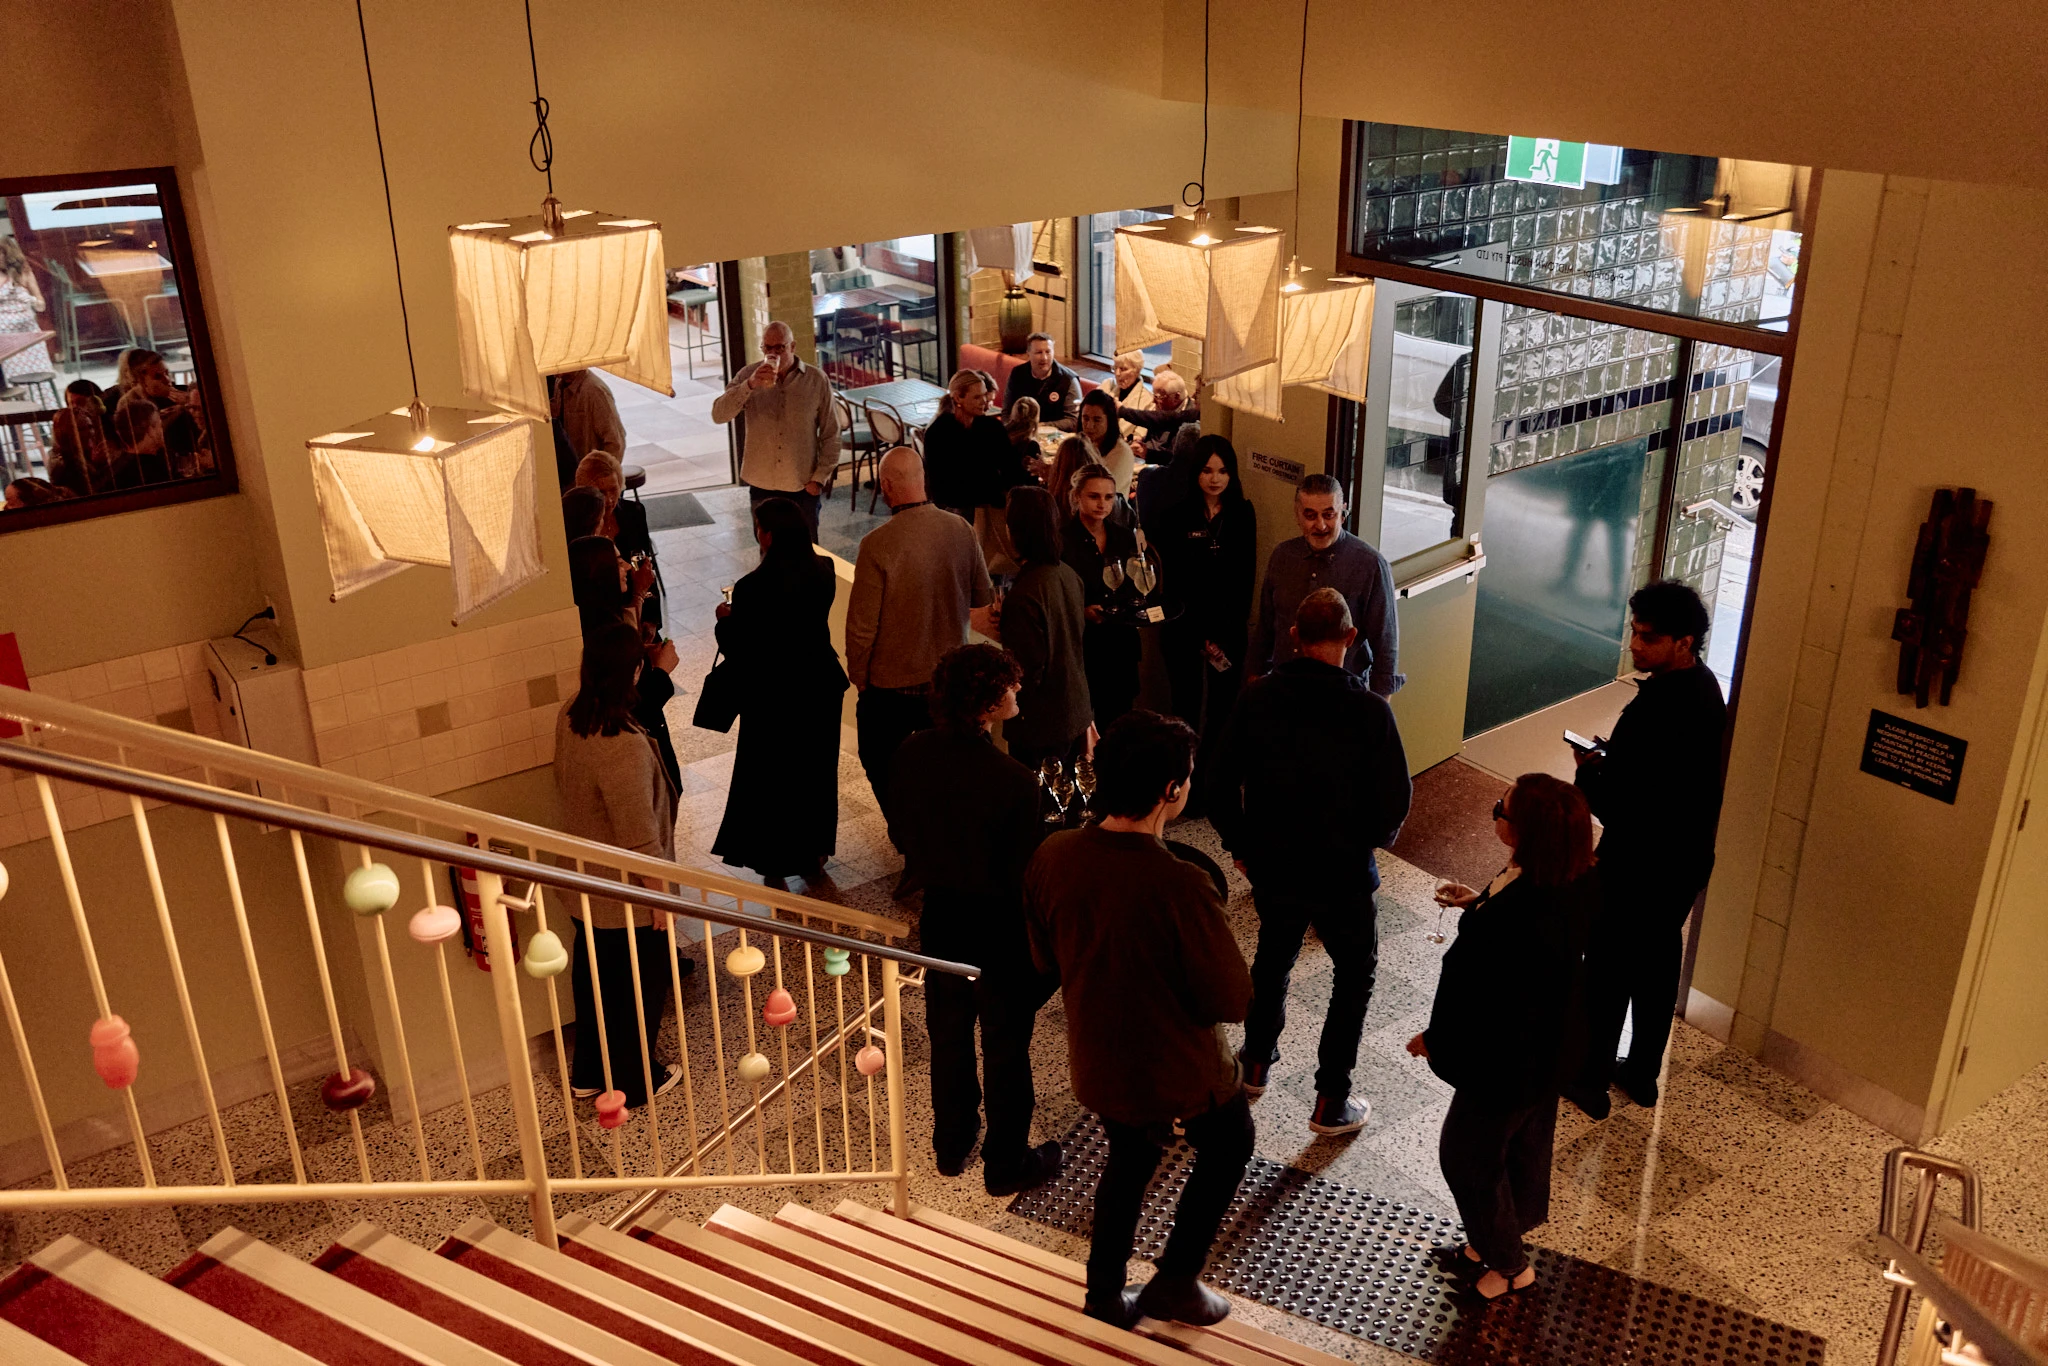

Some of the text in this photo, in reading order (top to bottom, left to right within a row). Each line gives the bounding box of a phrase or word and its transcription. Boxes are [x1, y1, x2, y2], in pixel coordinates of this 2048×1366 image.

[1252, 452, 1300, 474] FIRE CURTAIN
[1272, 469, 1297, 480] OBSTRUCT
[1885, 723, 1949, 750] PLEASE RESPECT OUR
[1881, 737, 1909, 750] MAINTAIN
[1916, 750, 1946, 764] PEACEFUL
[1914, 742, 1928, 750] AND
[1929, 746, 1944, 755] HELP
[1872, 748, 1889, 758] NOISE
[1904, 760, 1932, 773] MINIMUM
[1932, 771, 1952, 781] WHEN
[1875, 758, 1900, 770] LEAVING
[1902, 766, 1912, 774] THE
[1926, 761, 1952, 774] KEEPING
